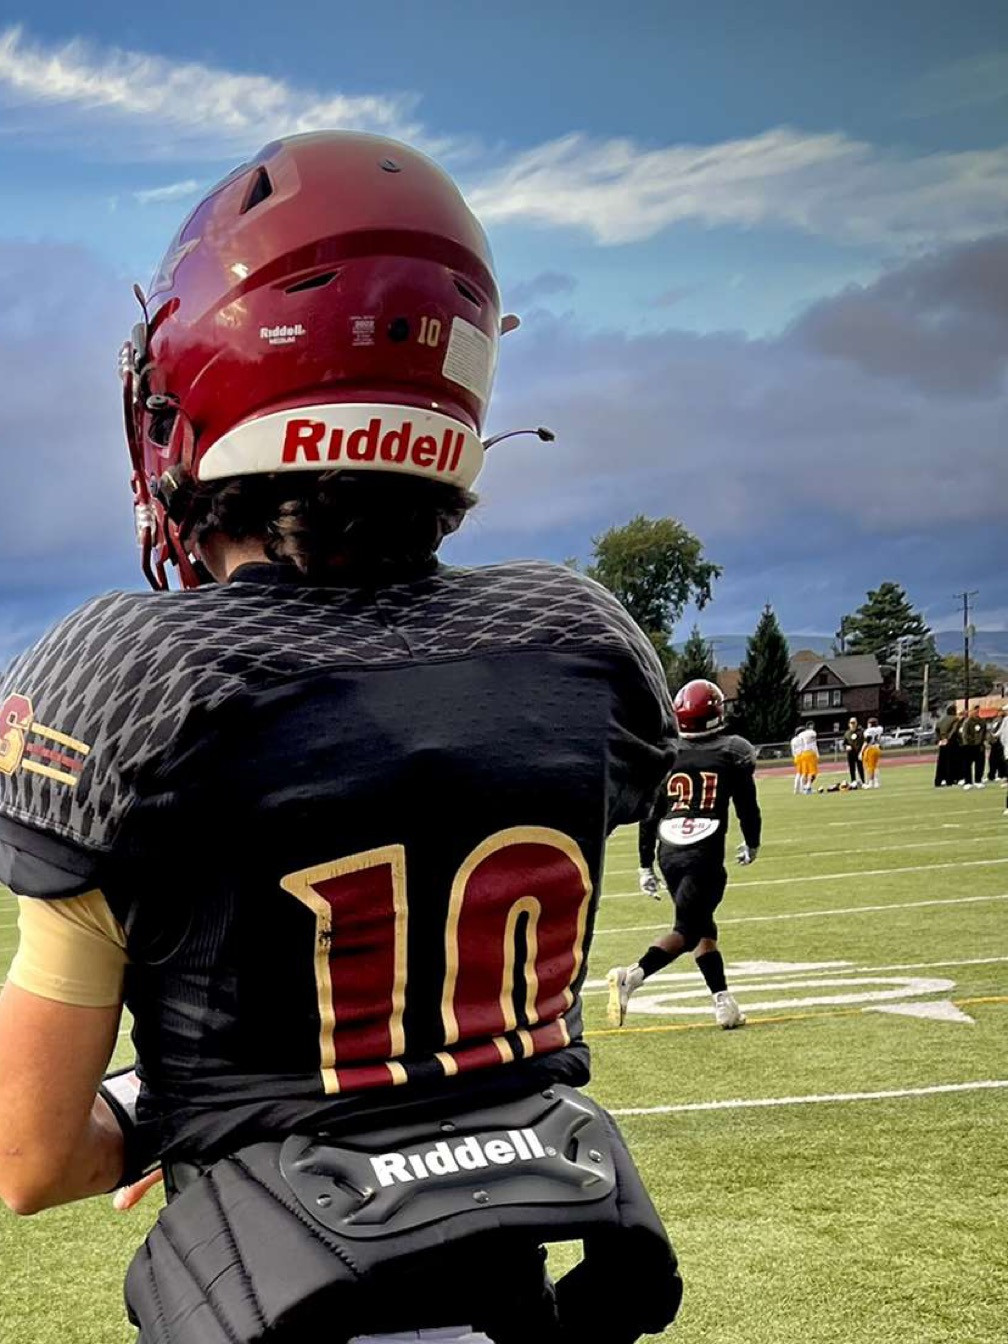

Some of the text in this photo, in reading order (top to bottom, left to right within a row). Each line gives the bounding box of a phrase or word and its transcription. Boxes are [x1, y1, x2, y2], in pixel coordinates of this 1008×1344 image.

[259, 324, 306, 339] Riddell
[417, 316, 442, 347] 10
[282, 418, 465, 472] Riddell
[667, 771, 718, 811] 21
[280, 825, 592, 1094] 10
[369, 1127, 548, 1188] Riddell
